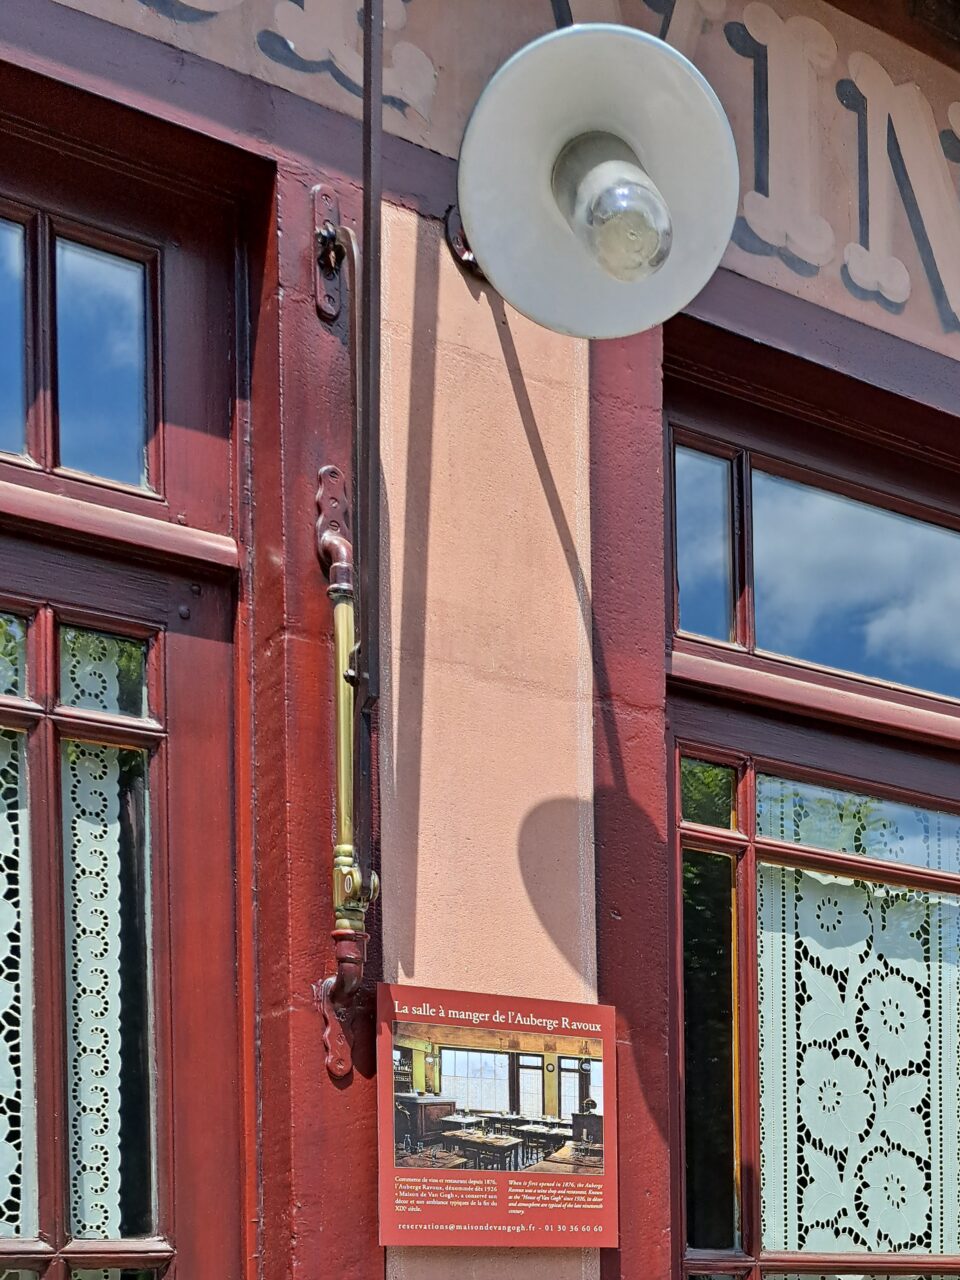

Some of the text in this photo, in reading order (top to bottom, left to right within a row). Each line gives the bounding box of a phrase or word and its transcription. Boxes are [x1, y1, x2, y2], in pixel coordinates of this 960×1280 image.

[394, 1000, 602, 1032] La salle à manger de l'Auberge Ravoux
[544, 1224, 554, 1232] 01
[557, 1224, 567, 1232] 30
[569, 1224, 578, 1232] 36
[581, 1224, 590, 1232] 60
[593, 1224, 603, 1232] 60
